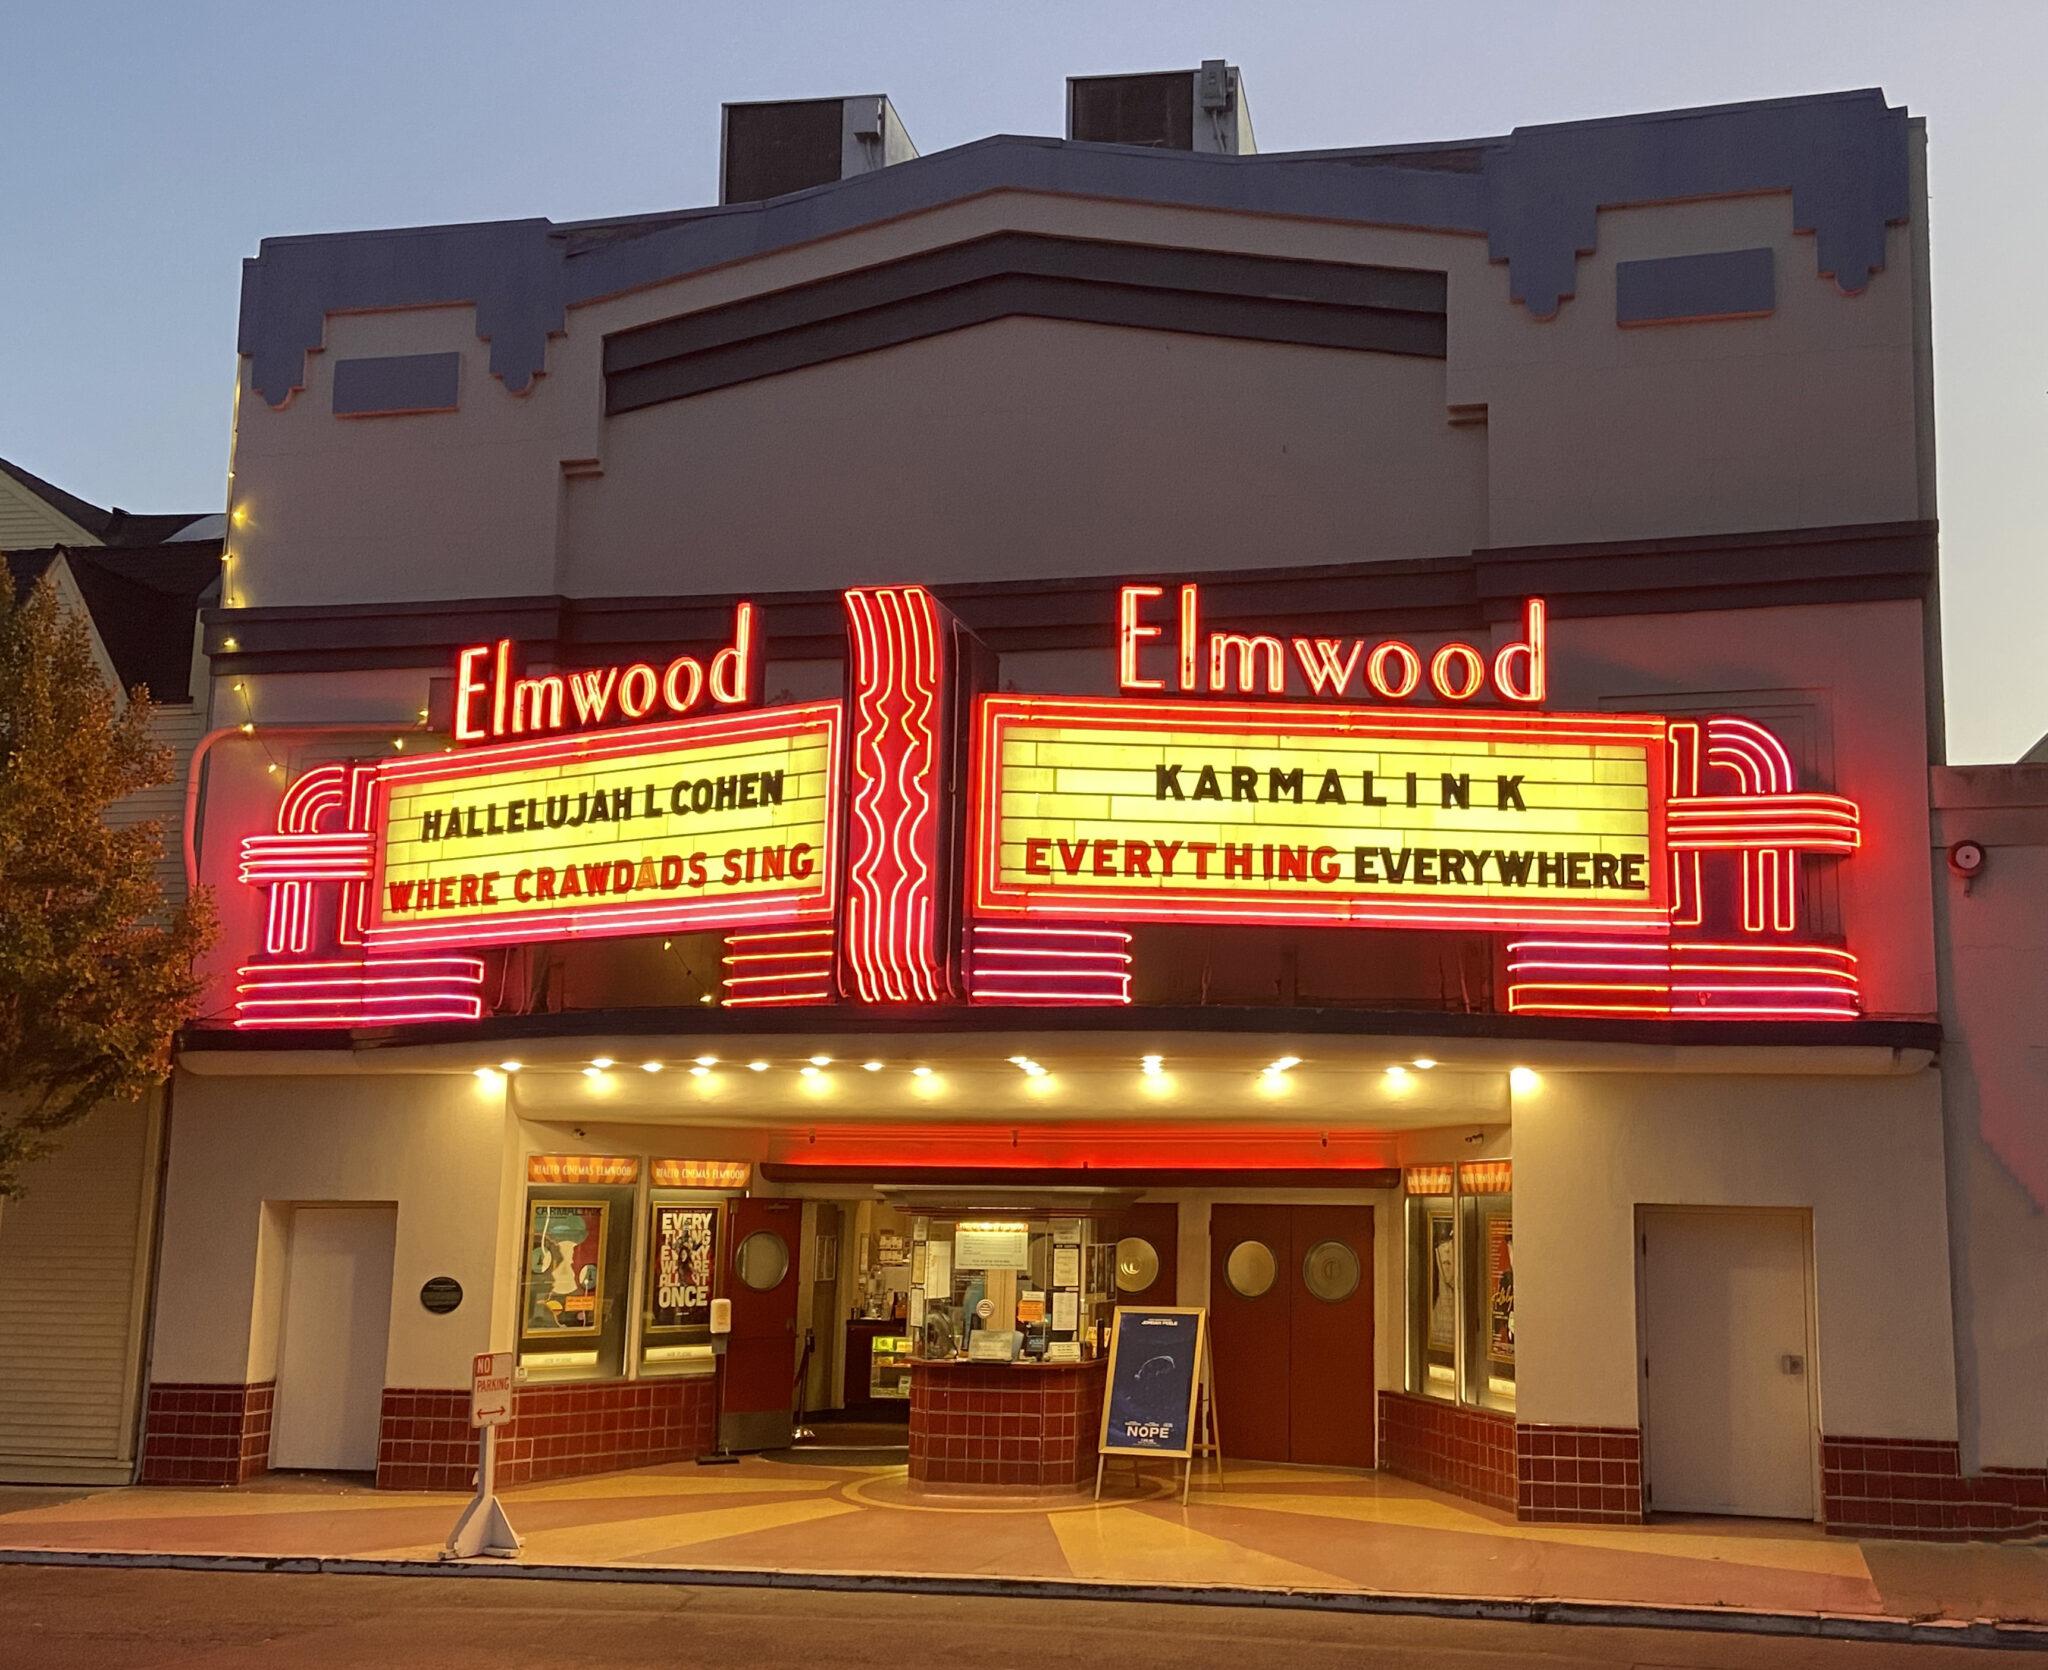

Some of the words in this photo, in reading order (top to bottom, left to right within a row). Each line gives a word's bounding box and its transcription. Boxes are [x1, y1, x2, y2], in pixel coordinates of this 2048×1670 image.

[1119, 583, 1547, 704] Elmwood
[454, 601, 752, 742] Elmwood
[1155, 764, 1528, 812] KARMALINK
[421, 785, 633, 843] HALLELUJAH
[643, 783, 663, 819] L
[670, 768, 784, 816] COHEN
[1025, 838, 1341, 884] EVERYTHING
[1354, 846, 1646, 891] EVERYWHERE
[388, 870, 500, 914] WHERE
[513, 851, 708, 904] CRAWDADS
[721, 842, 815, 886] SING
[563, 1164, 594, 1176] CINEMAS
[596, 1165, 633, 1177] ELMWOOD
[682, 1168, 710, 1179] CINEMAS
[712, 1169, 745, 1180] ELMWOOD
[661, 1212, 712, 1230] EVERY
[660, 1245, 711, 1261] EVRY
[660, 1260, 710, 1274] WHRE
[658, 1286, 708, 1309] ONCE
[477, 1356, 491, 1375] NO
[477, 1376, 510, 1393] PARKING
[1126, 1425, 1170, 1439] NOPE
